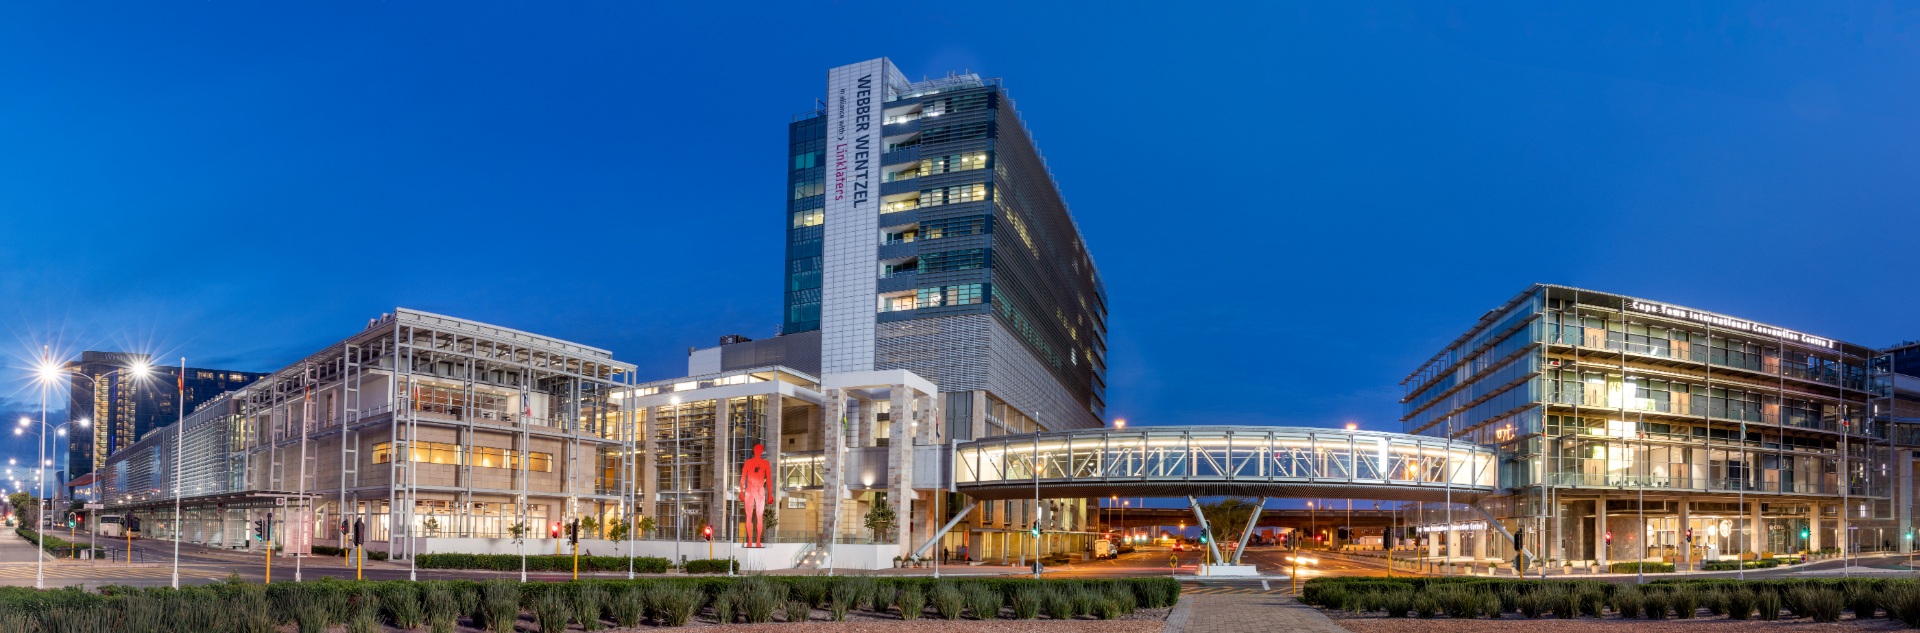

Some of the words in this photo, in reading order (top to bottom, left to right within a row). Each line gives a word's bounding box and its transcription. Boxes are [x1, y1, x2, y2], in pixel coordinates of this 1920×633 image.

[856, 74, 871, 132] WEBBER
[835, 143, 848, 201] Linklaters
[854, 134, 869, 208] WENTZEL
[1632, 301, 1657, 312] Cape
[1661, 305, 1686, 318] Town
[1689, 311, 1750, 331] International
[1752, 323, 1799, 340] Convention
[1801, 334, 1827, 347] Centre
